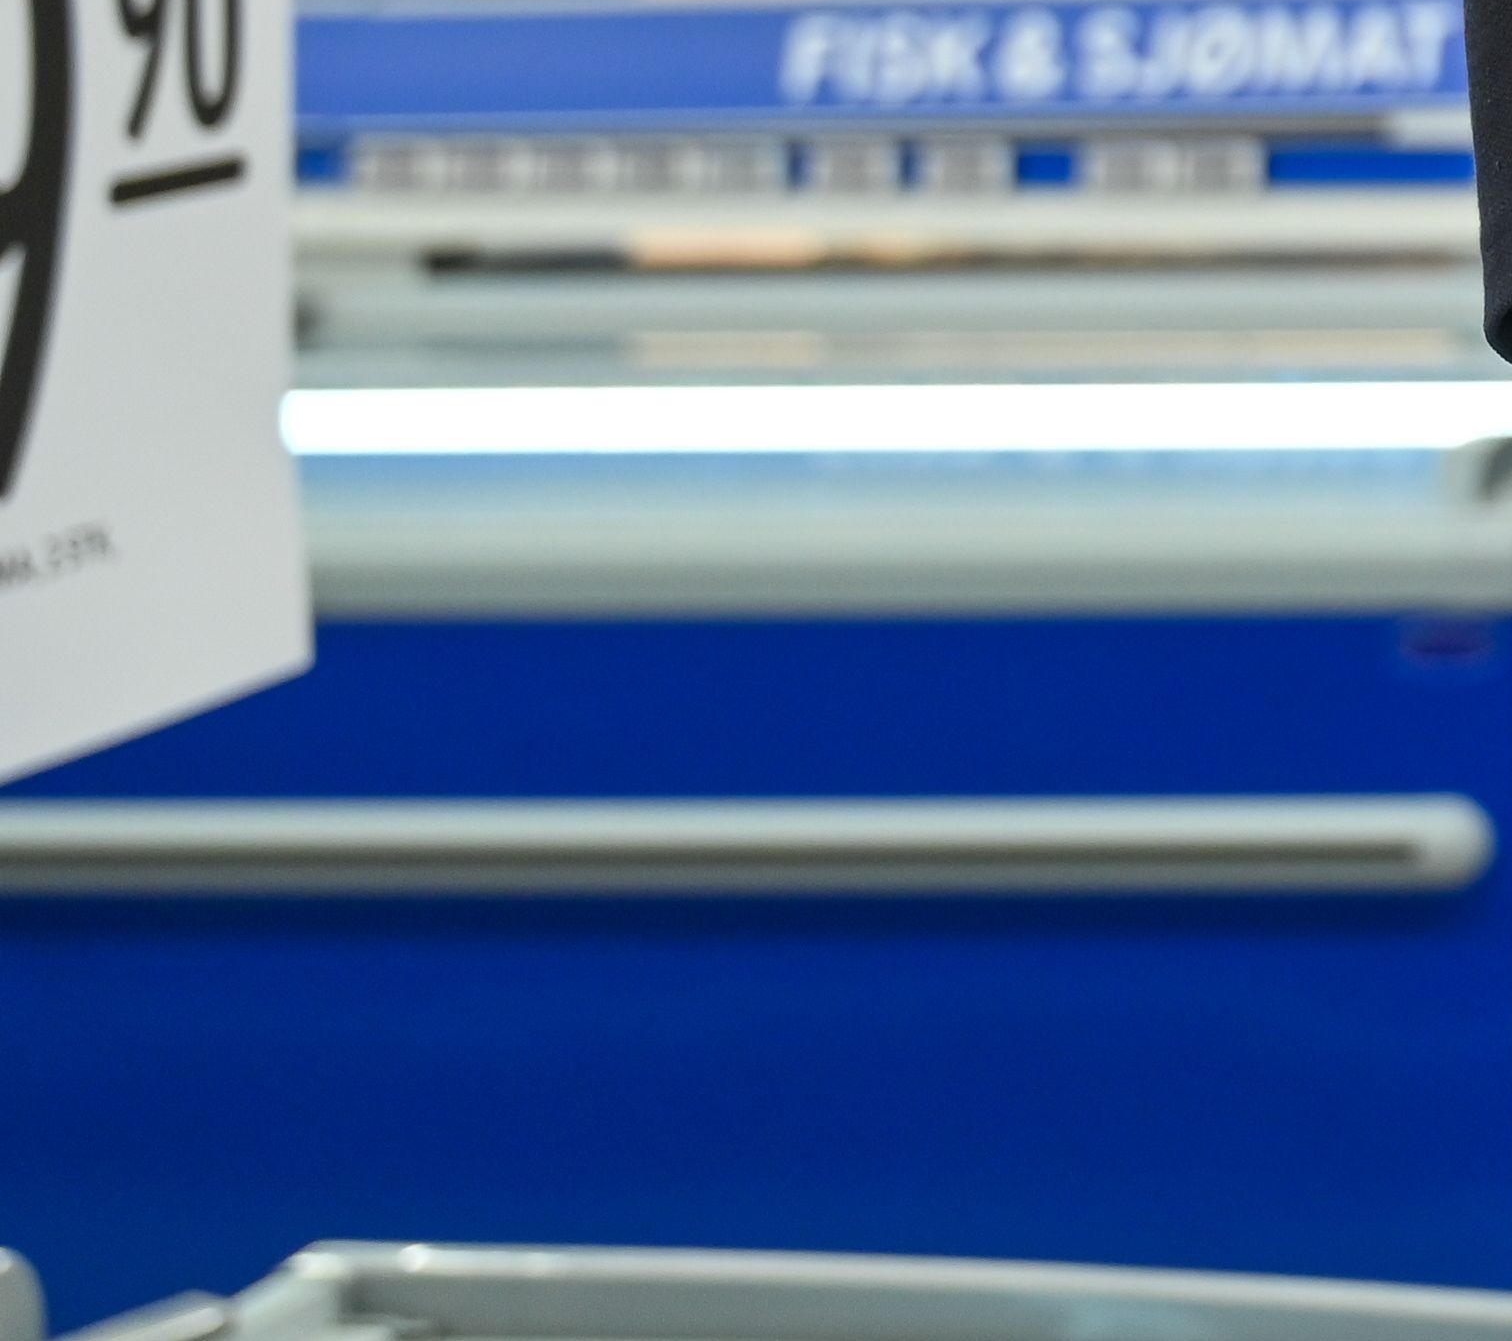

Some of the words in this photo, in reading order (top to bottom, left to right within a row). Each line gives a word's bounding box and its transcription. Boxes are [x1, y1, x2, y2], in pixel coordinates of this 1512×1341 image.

[782, 12, 994, 104] FISK
[1000, 8, 1064, 101] &
[1076, 2, 1452, 98] SJØMAT
